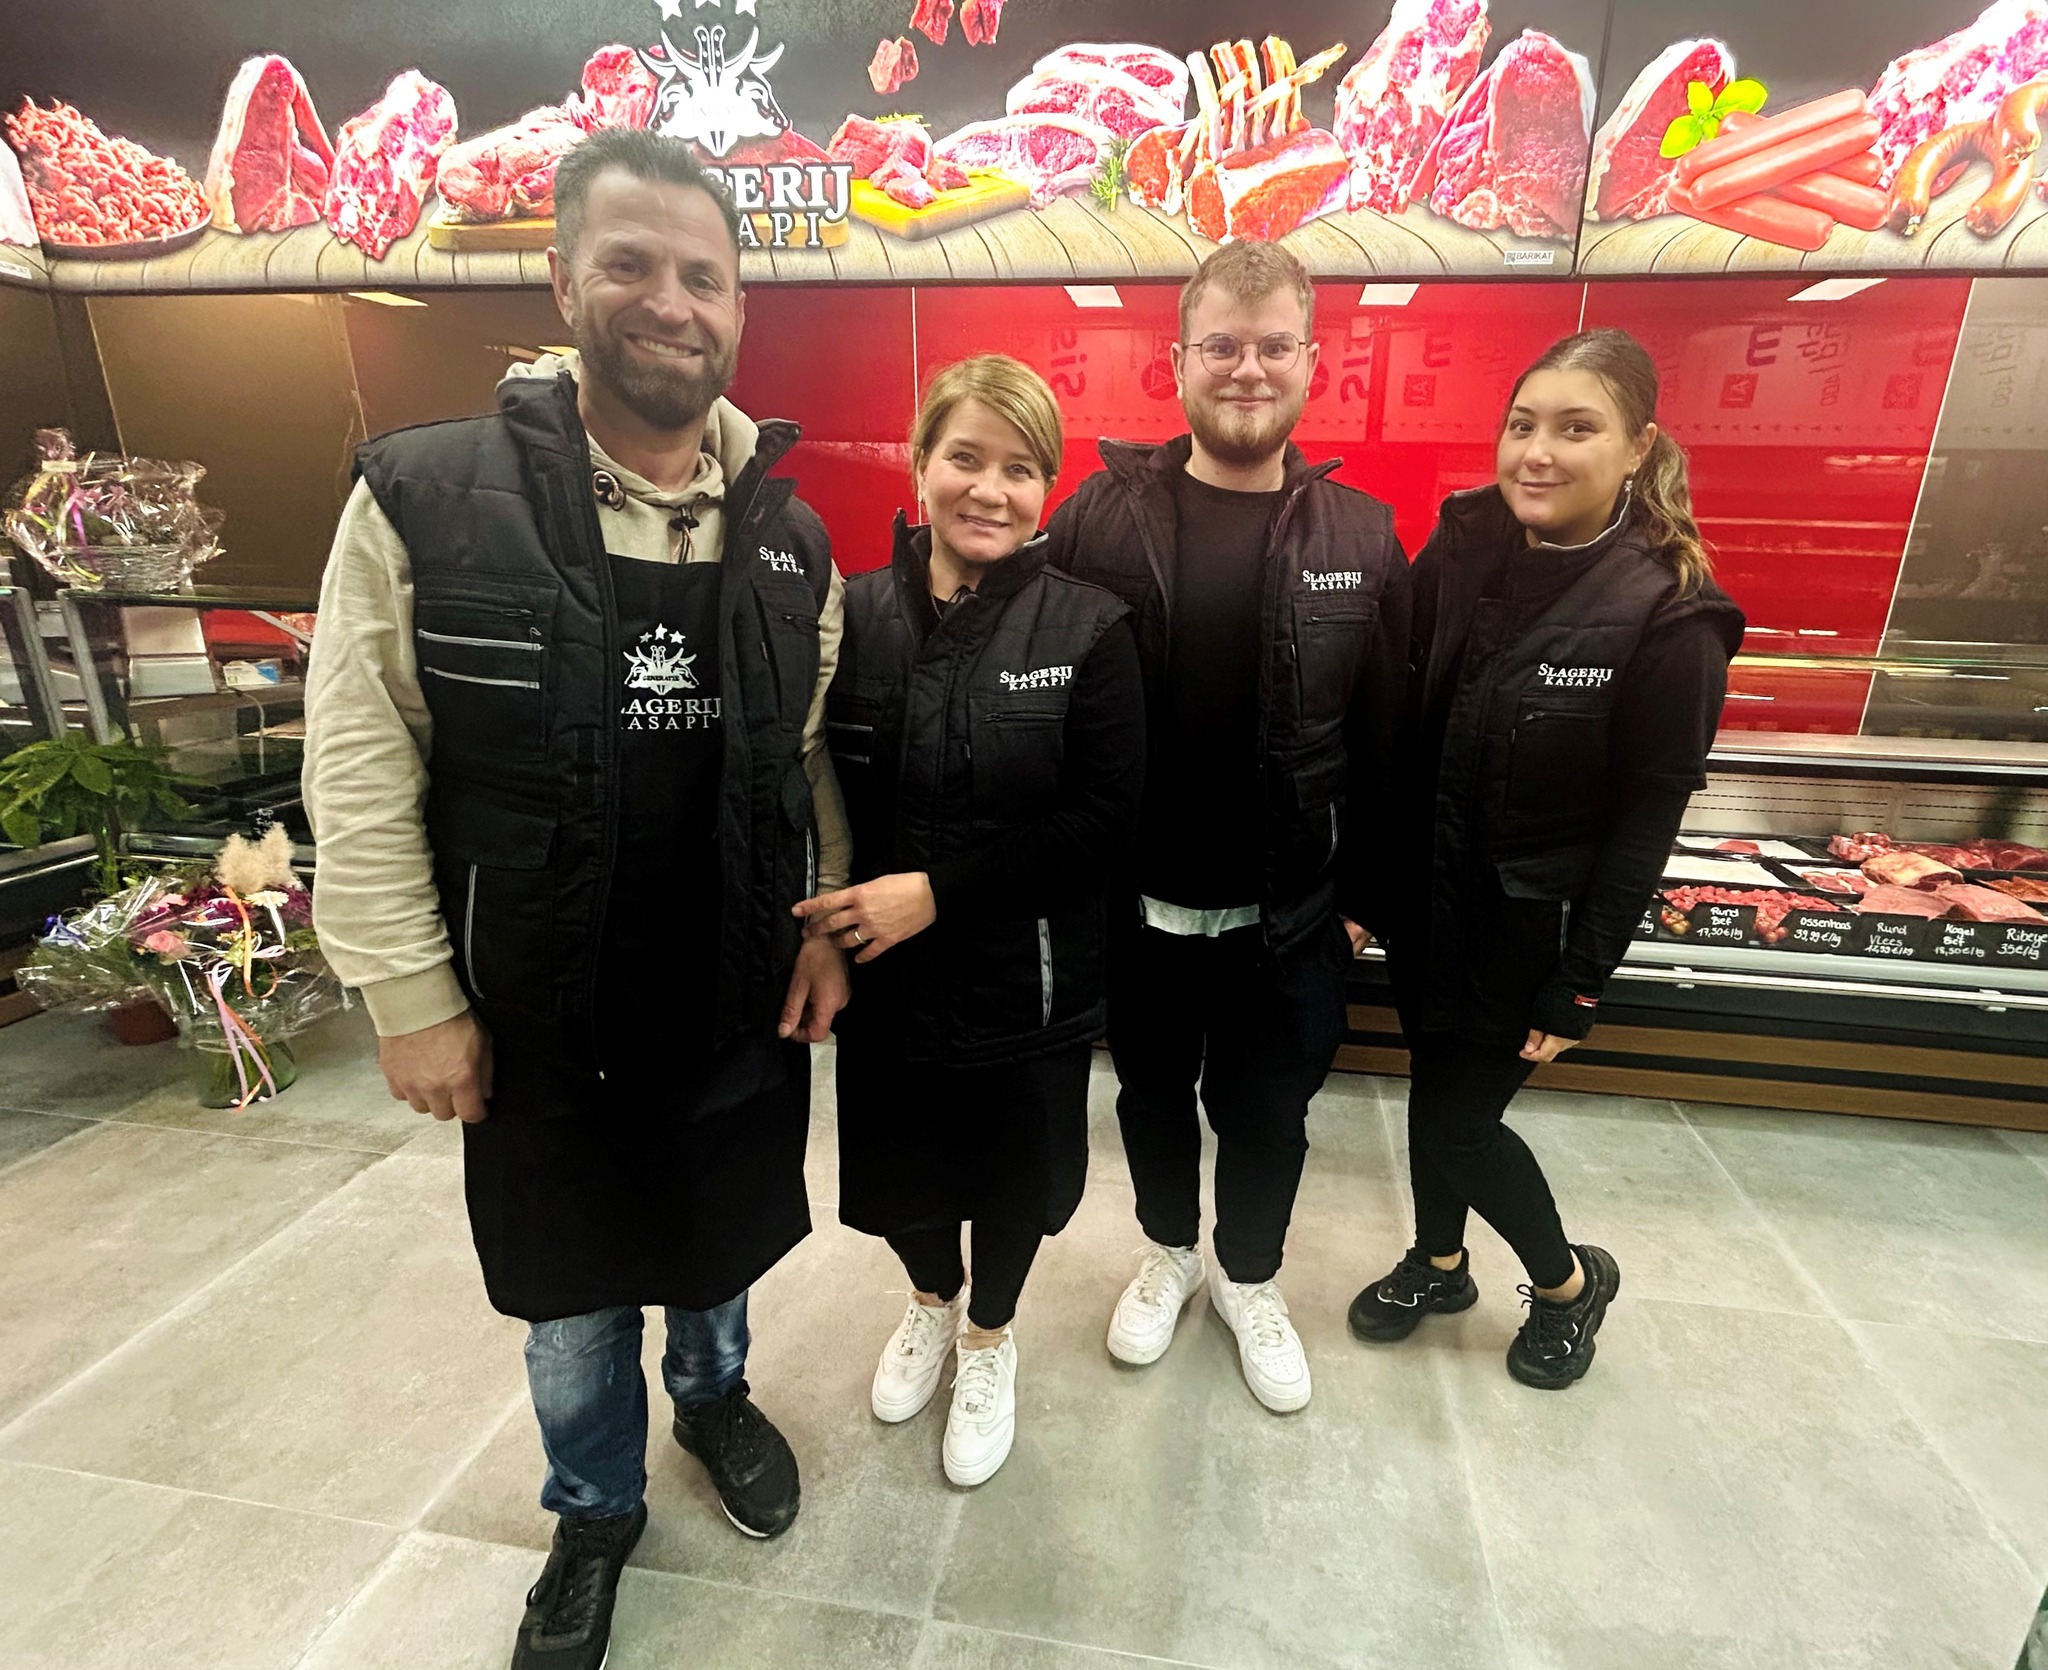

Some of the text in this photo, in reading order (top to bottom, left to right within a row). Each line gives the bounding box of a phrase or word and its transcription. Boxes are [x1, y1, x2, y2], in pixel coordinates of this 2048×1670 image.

[706, 164, 853, 221] ERIJ
[1516, 251, 1552, 260] BARIKAT
[1302, 569, 1362, 584] SLAGERIJ
[1310, 580, 1357, 591] KASAPI
[999, 665, 1074, 684] SLAGERIJ
[1538, 663, 1614, 681] SLAGERIJ
[1008, 675, 1066, 691] KASAPI
[1544, 676, 1602, 688] KASAPI
[620, 697, 722, 719] AGERIJ
[620, 714, 711, 731] ASAPI
[1709, 906, 1740, 918] Rund
[1876, 922, 1907, 936] Rund
[1944, 923, 1975, 939] Kogel
[1869, 934, 1903, 948] Vlees
[2005, 927, 2048, 949] Ribeye
